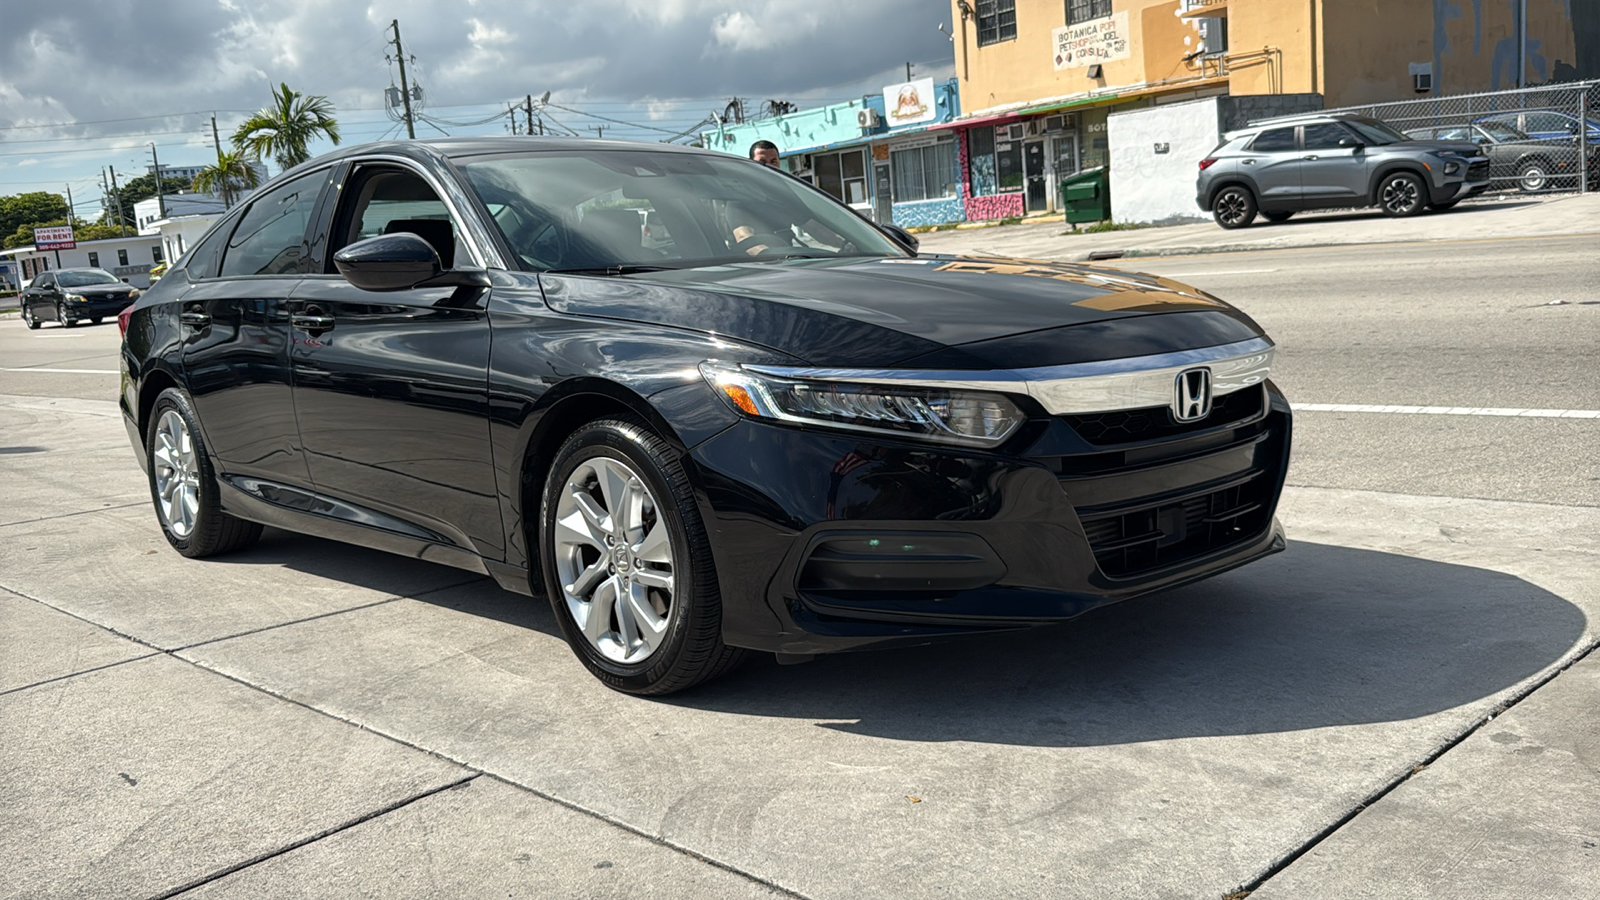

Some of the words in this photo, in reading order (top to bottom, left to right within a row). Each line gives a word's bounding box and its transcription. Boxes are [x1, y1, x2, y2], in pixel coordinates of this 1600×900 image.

[1058, 24, 1098, 42] BOTANICA
[1101, 31, 1119, 42] JOEL
[1087, 123, 1107, 133] BOT
[1182, 370, 1205, 419] H
